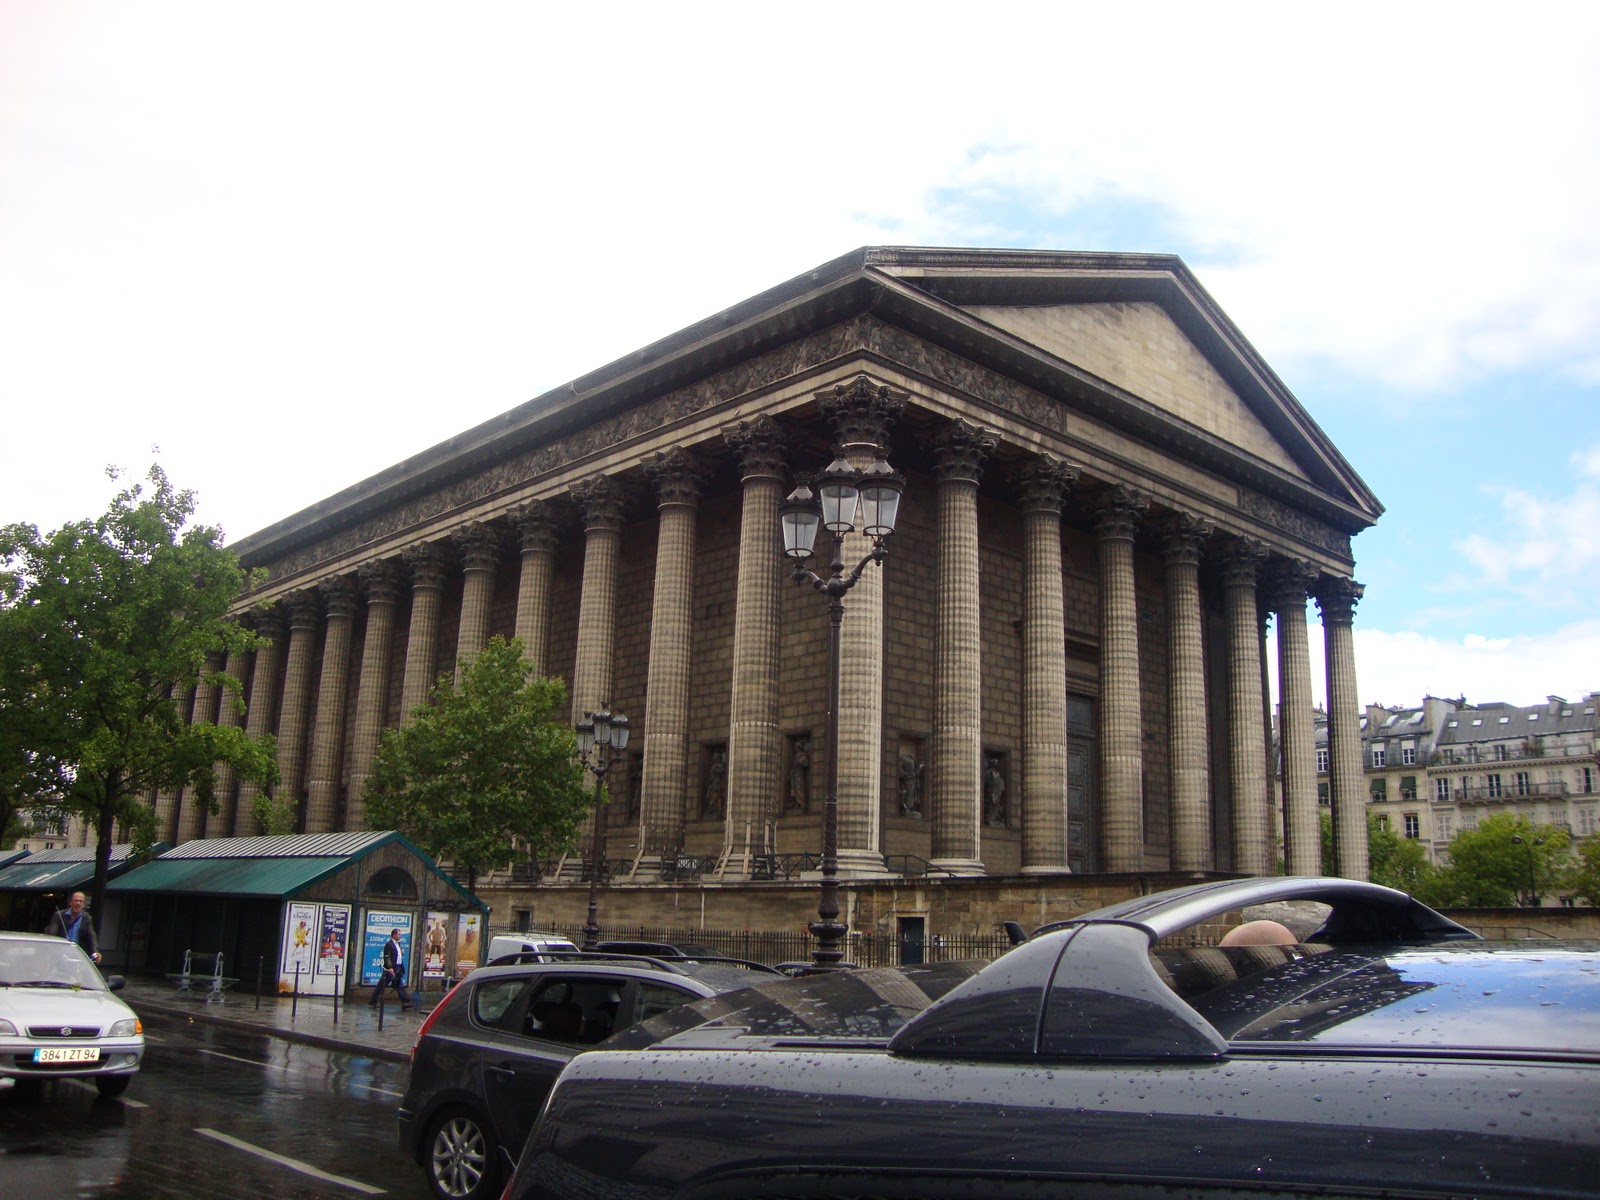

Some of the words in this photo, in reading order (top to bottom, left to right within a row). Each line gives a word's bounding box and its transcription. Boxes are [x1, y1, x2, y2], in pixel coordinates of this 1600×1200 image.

[370, 914, 408, 924] DECATHLON
[42, 1050, 67, 1061] 3841
[69, 1050, 82, 1060] ZT
[83, 1049, 96, 1060] 94
